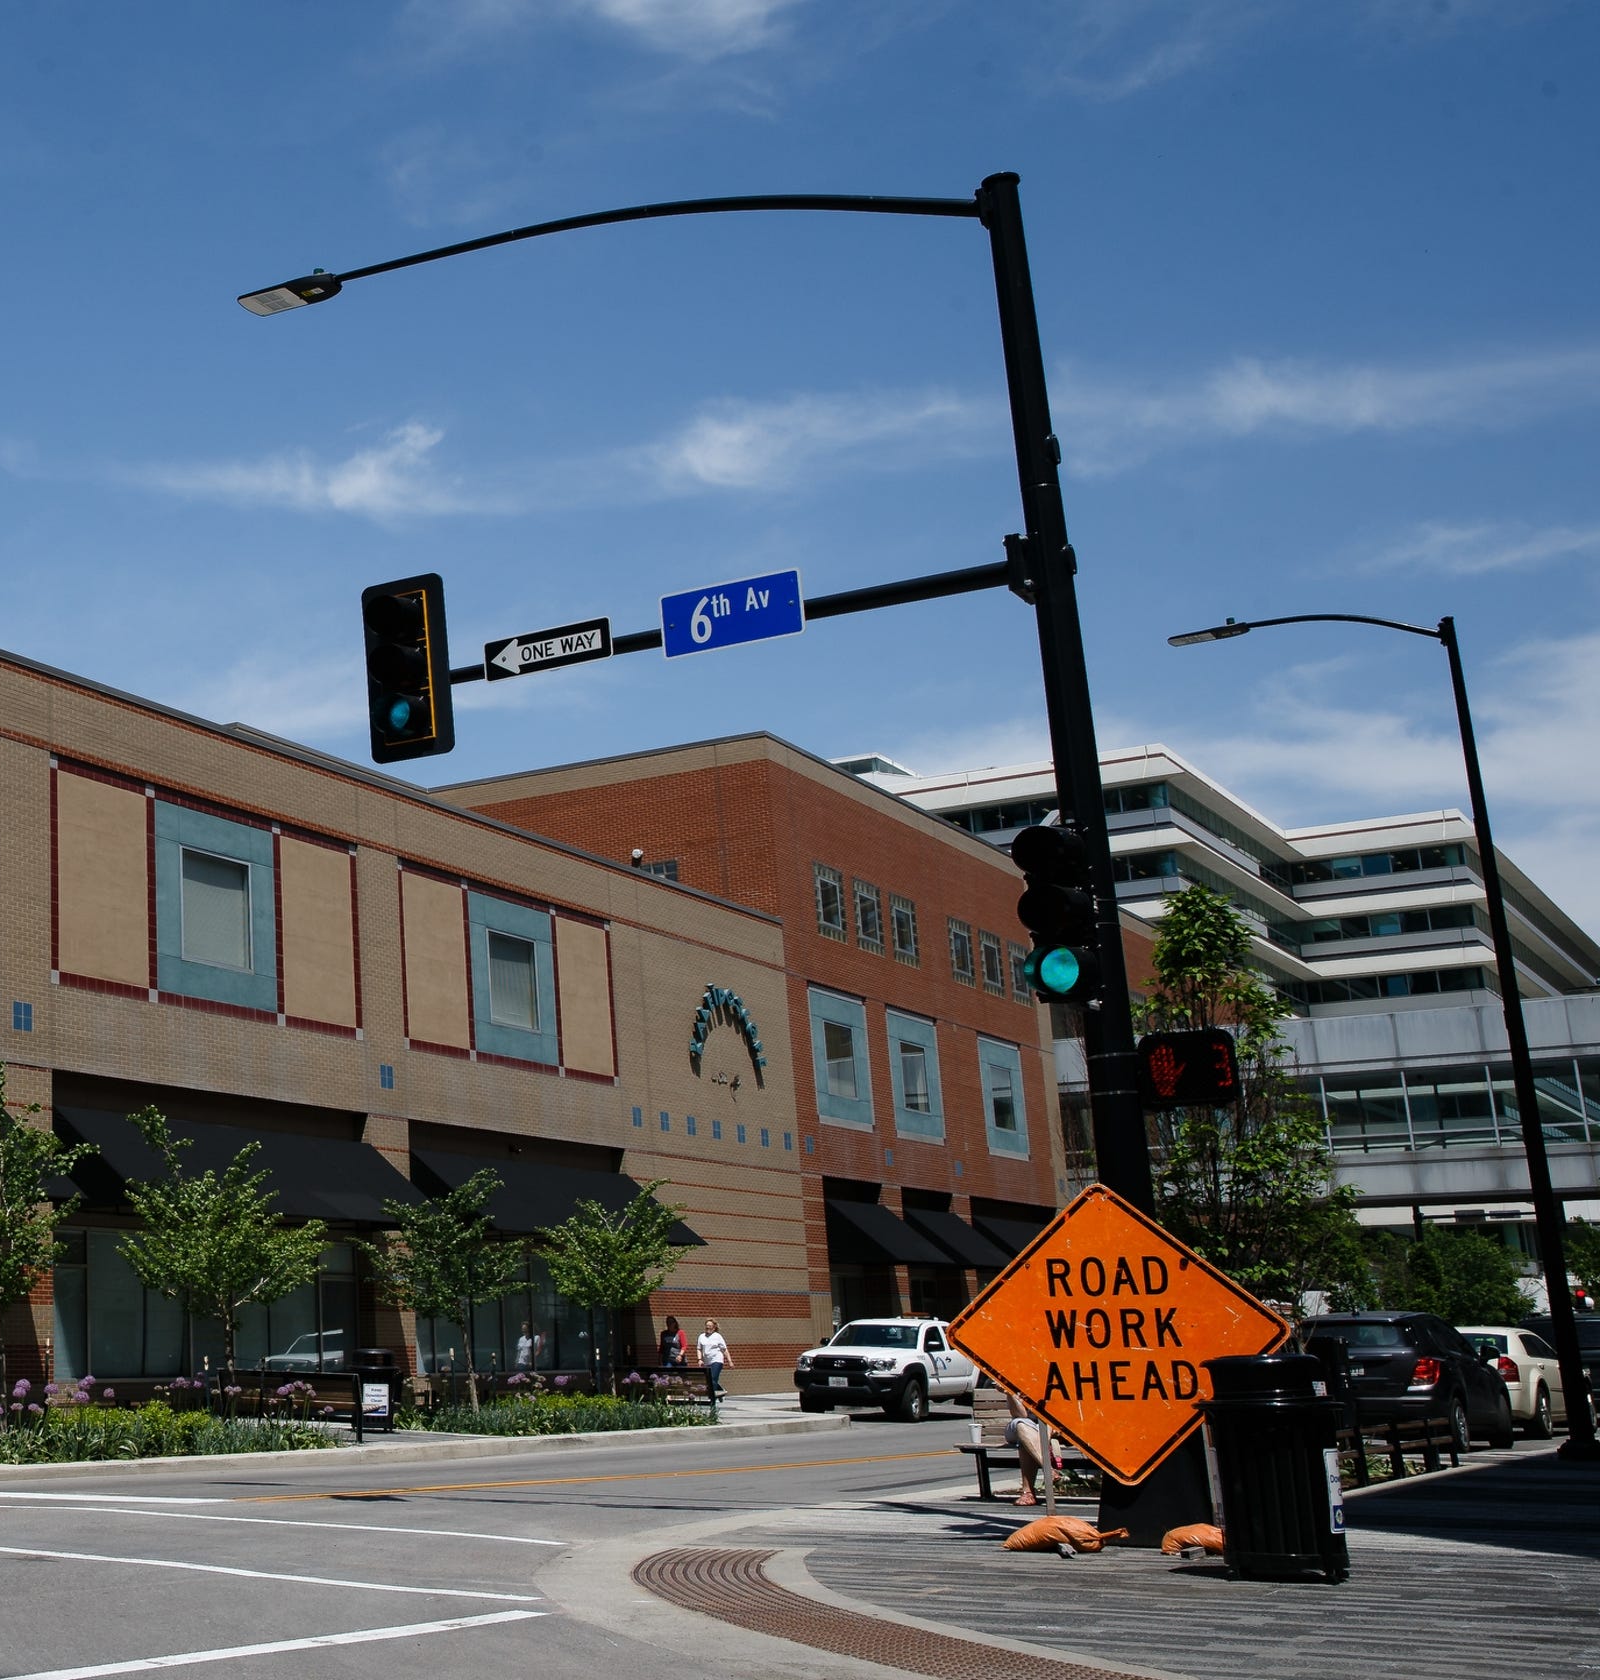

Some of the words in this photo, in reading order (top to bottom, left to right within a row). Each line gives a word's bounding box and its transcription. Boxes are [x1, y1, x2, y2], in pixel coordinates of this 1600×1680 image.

[690, 593, 731, 644] 6th
[745, 587, 770, 612] Av
[520, 641, 554, 662] ONE
[561, 632, 597, 654] WAY
[1212, 1043, 1233, 1087] 3
[1045, 1256, 1169, 1298] ROAD
[1045, 1307, 1183, 1349] WORK
[1044, 1360, 1199, 1401] AHEAD
